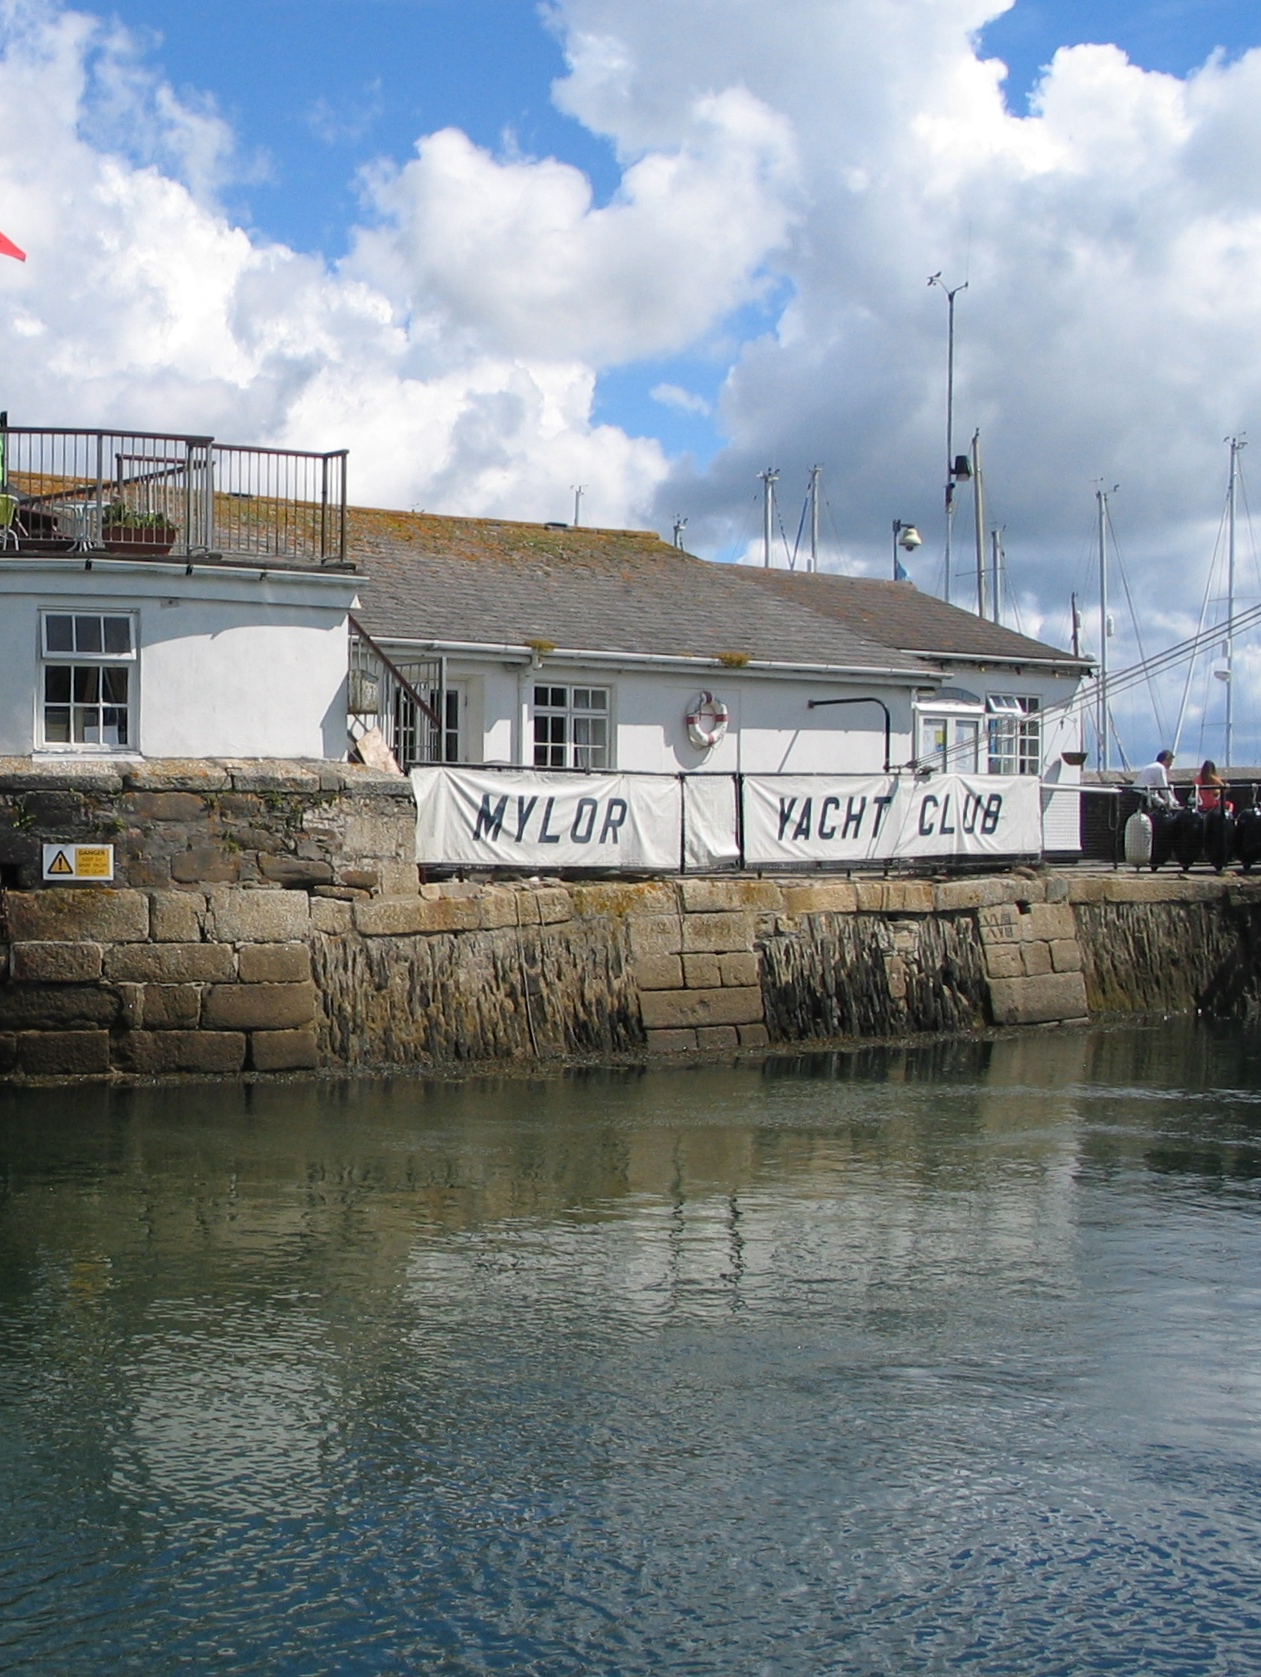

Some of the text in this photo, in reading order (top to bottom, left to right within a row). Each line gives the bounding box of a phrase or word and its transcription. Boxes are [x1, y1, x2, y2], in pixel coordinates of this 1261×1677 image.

[473, 793, 628, 844] MYLOR
[777, 793, 1003, 840] YACHT CLUB
